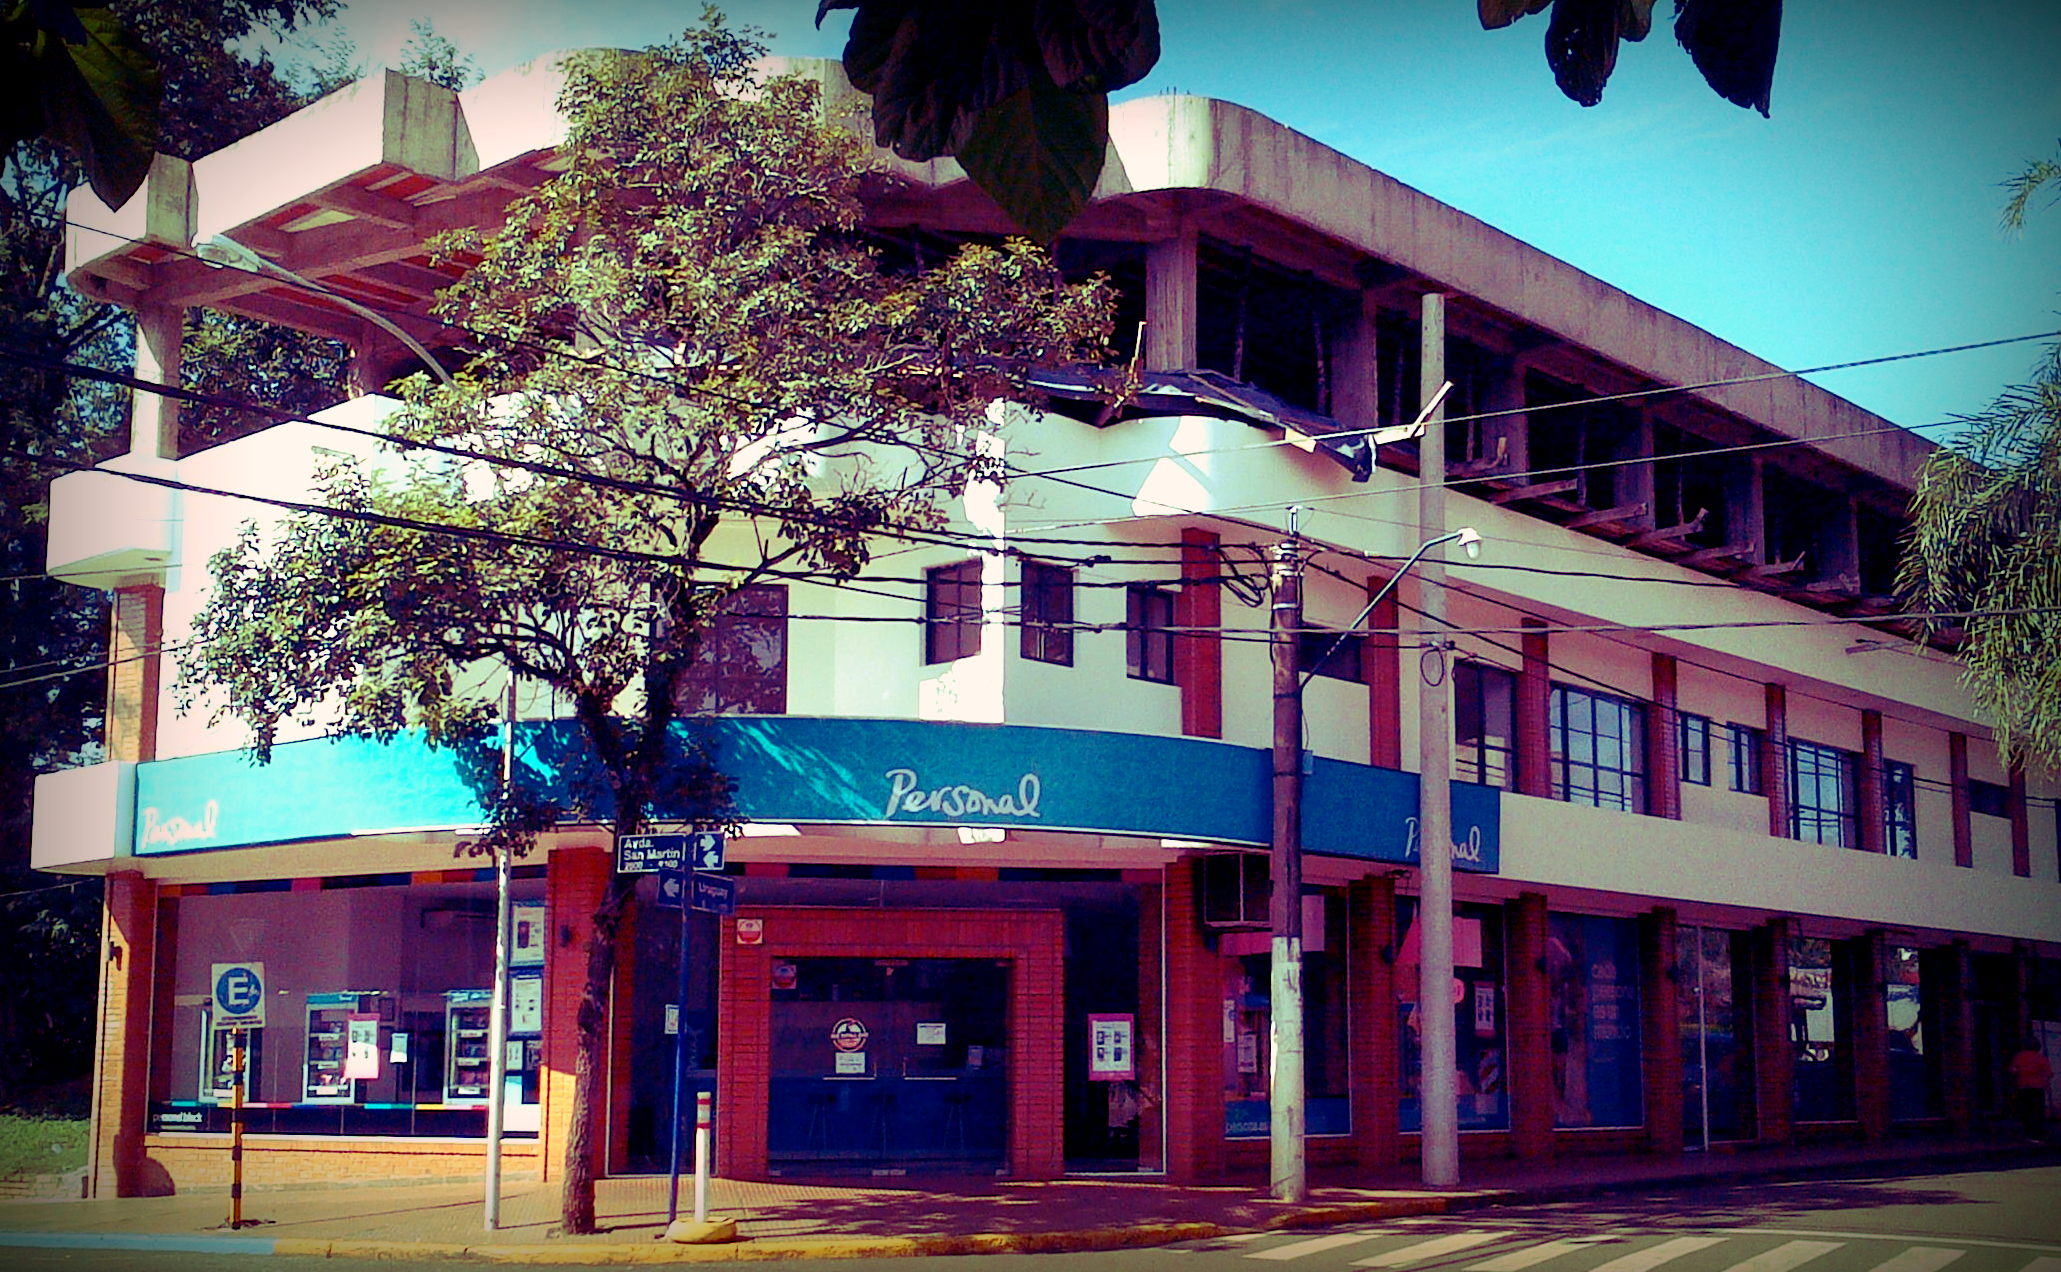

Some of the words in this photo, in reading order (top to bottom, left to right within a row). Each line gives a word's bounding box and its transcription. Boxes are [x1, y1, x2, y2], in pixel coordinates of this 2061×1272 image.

[885, 768, 1041, 819] Personal
[624, 850, 644, 861] San
[228, 976, 249, 1005] E
